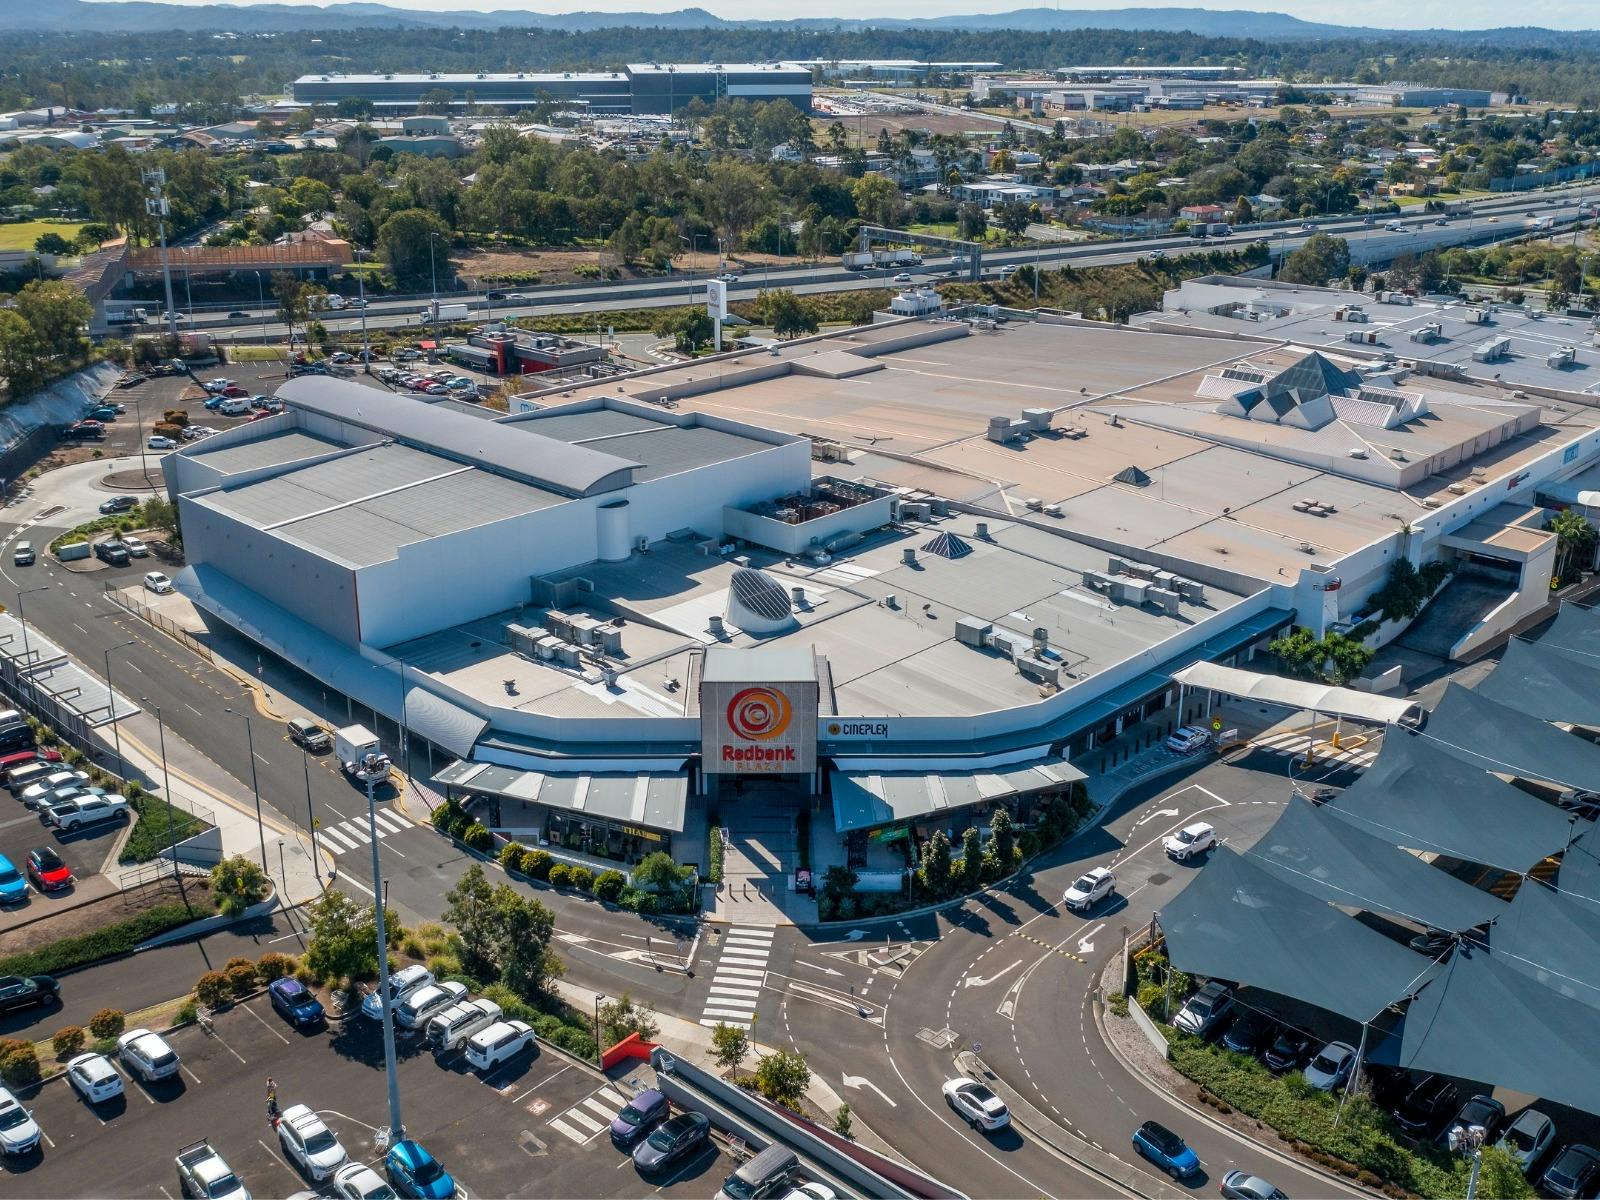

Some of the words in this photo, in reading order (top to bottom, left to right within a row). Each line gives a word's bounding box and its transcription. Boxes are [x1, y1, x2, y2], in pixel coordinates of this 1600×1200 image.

[843, 723, 888, 739] CINEPLEX
[722, 745, 796, 761] Redbank
[736, 762, 784, 771] PLAZA
